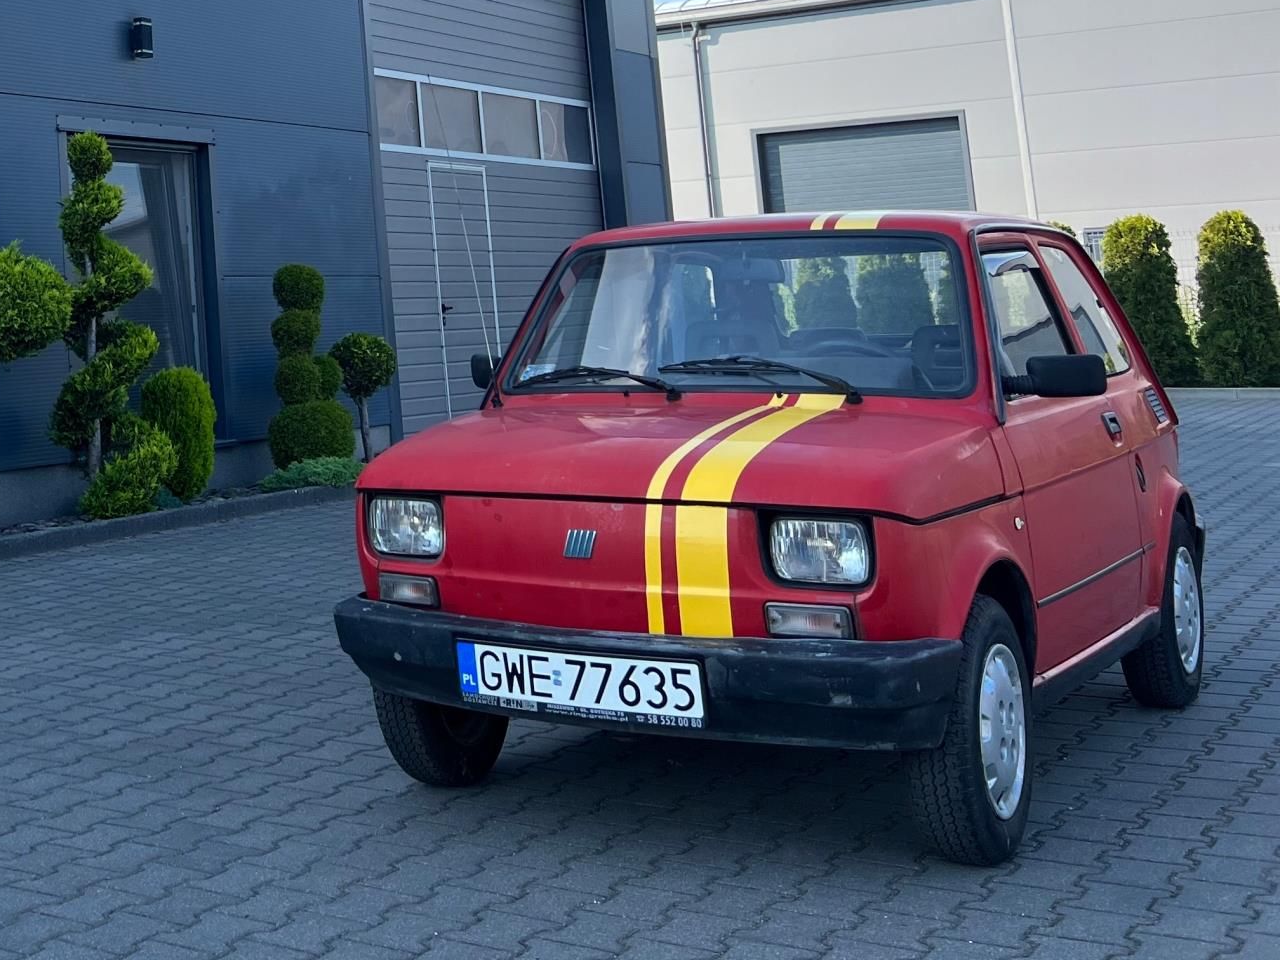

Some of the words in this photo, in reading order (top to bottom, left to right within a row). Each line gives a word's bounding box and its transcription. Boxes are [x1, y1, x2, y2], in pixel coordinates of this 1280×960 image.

[462, 673, 476, 686] PL
[479, 650, 553, 698] GWE
[564, 658, 696, 712] 77635
[647, 714, 658, 724] 58
[660, 715, 677, 726] 552
[677, 716, 689, 727] 00
[690, 717, 702, 728] 80
